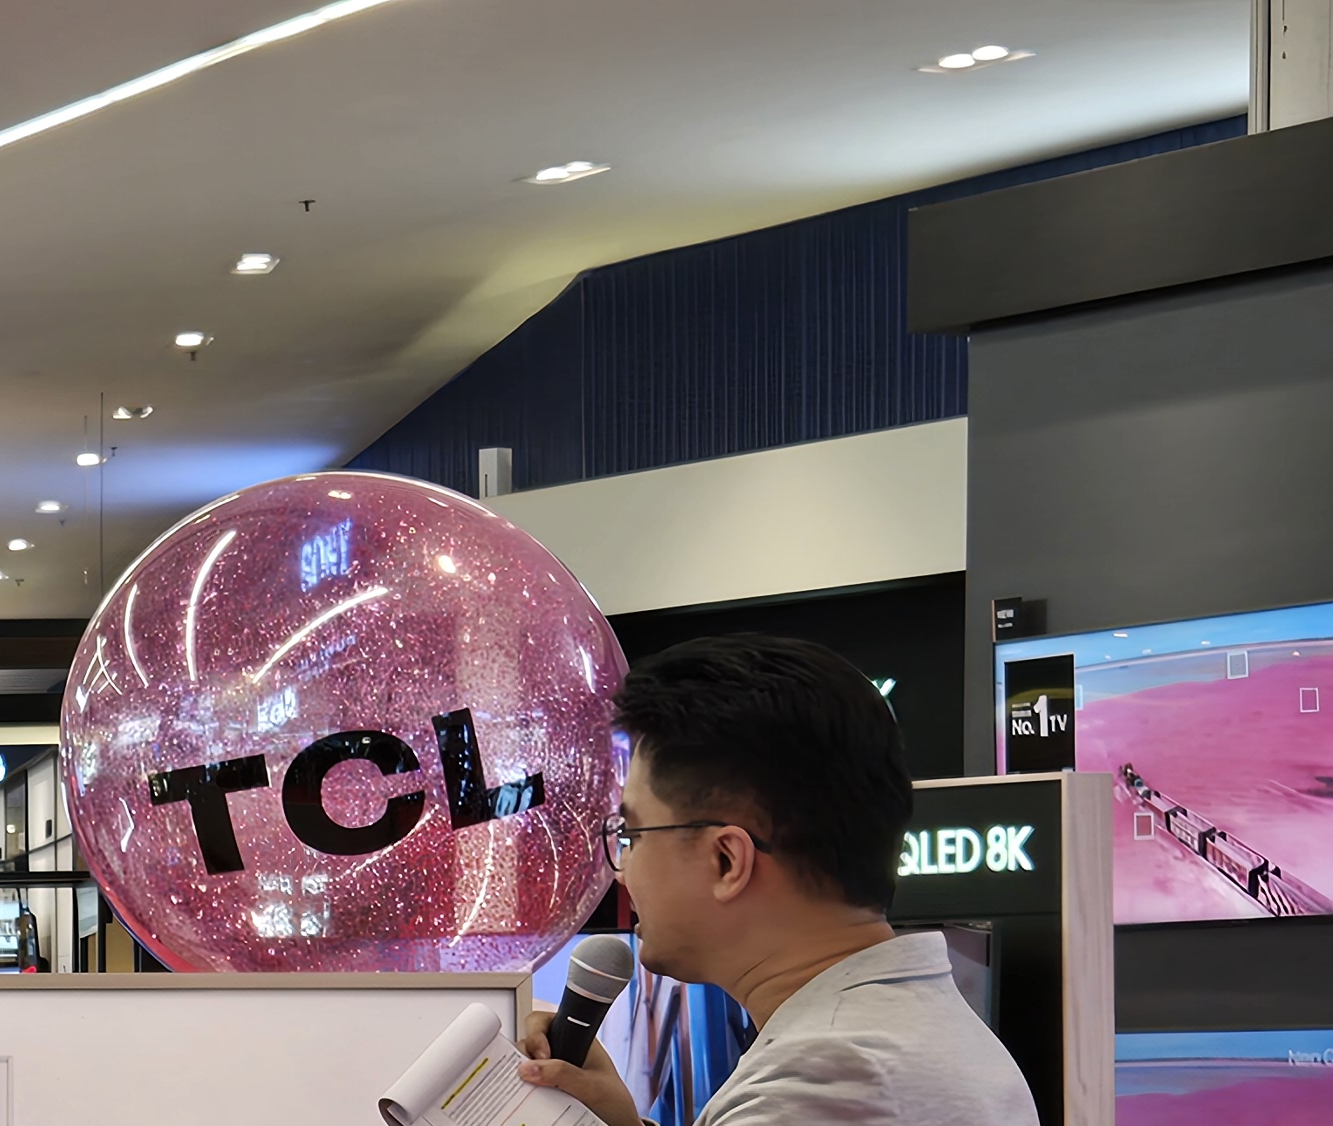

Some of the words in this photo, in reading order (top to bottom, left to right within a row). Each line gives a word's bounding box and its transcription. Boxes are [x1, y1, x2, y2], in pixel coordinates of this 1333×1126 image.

[1033, 694, 1049, 737] 1
[1050, 714, 1068, 733] TV
[148, 707, 545, 876] TCL
[985, 825, 1035, 872] 8K
